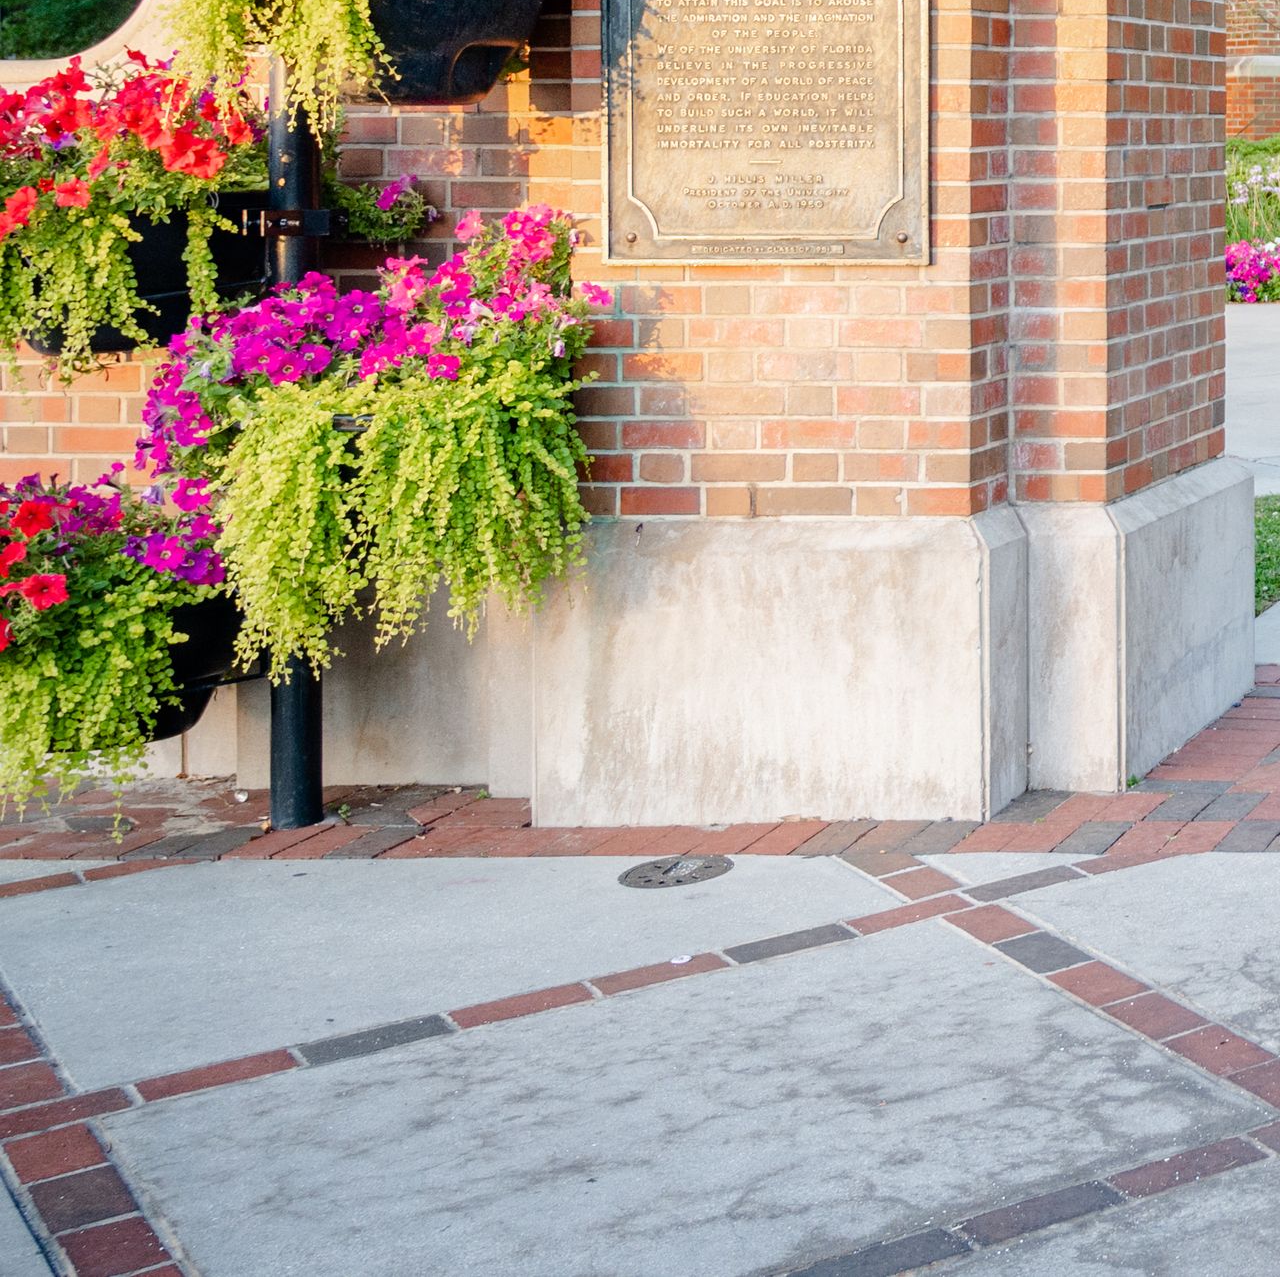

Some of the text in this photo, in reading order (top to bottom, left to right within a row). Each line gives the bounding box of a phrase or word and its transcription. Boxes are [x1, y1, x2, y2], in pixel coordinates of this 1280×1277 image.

[656, 14, 874, 22] THE ADMIRATION AND THE IMAGINATION
[712, 30, 728, 38] OF
[734, 30, 758, 38] THE
[657, 44, 873, 54] WE OF THE UNIVERSITY OF FLORIDA
[657, 62, 873, 70] BELIEVE IN THE PROGRESSIVE
[657, 78, 873, 86] DEVELOPMENT OF A WORLD OF PEACE
[657, 93, 681, 102] AND
[758, 93, 828, 102] EDUCATION
[838, 93, 874, 102] HELPS
[656, 108, 673, 118] TO
[680, 108, 714, 118] BUILD
[720, 108, 752, 118] SUCH
[758, 108, 766, 118] A
[826, 108, 838, 118] IT
[844, 108, 874, 118] WILL
[657, 125, 873, 133] UNDERLINE ITS OWN INEVITABLE
[657, 140, 740, 149] IMMORTALITY
[748, 140, 770, 149] FOR
[779, 140, 802, 149] ALL
[725, 175, 766, 184] HILLIS
[775, 175, 824, 184] MILLER
